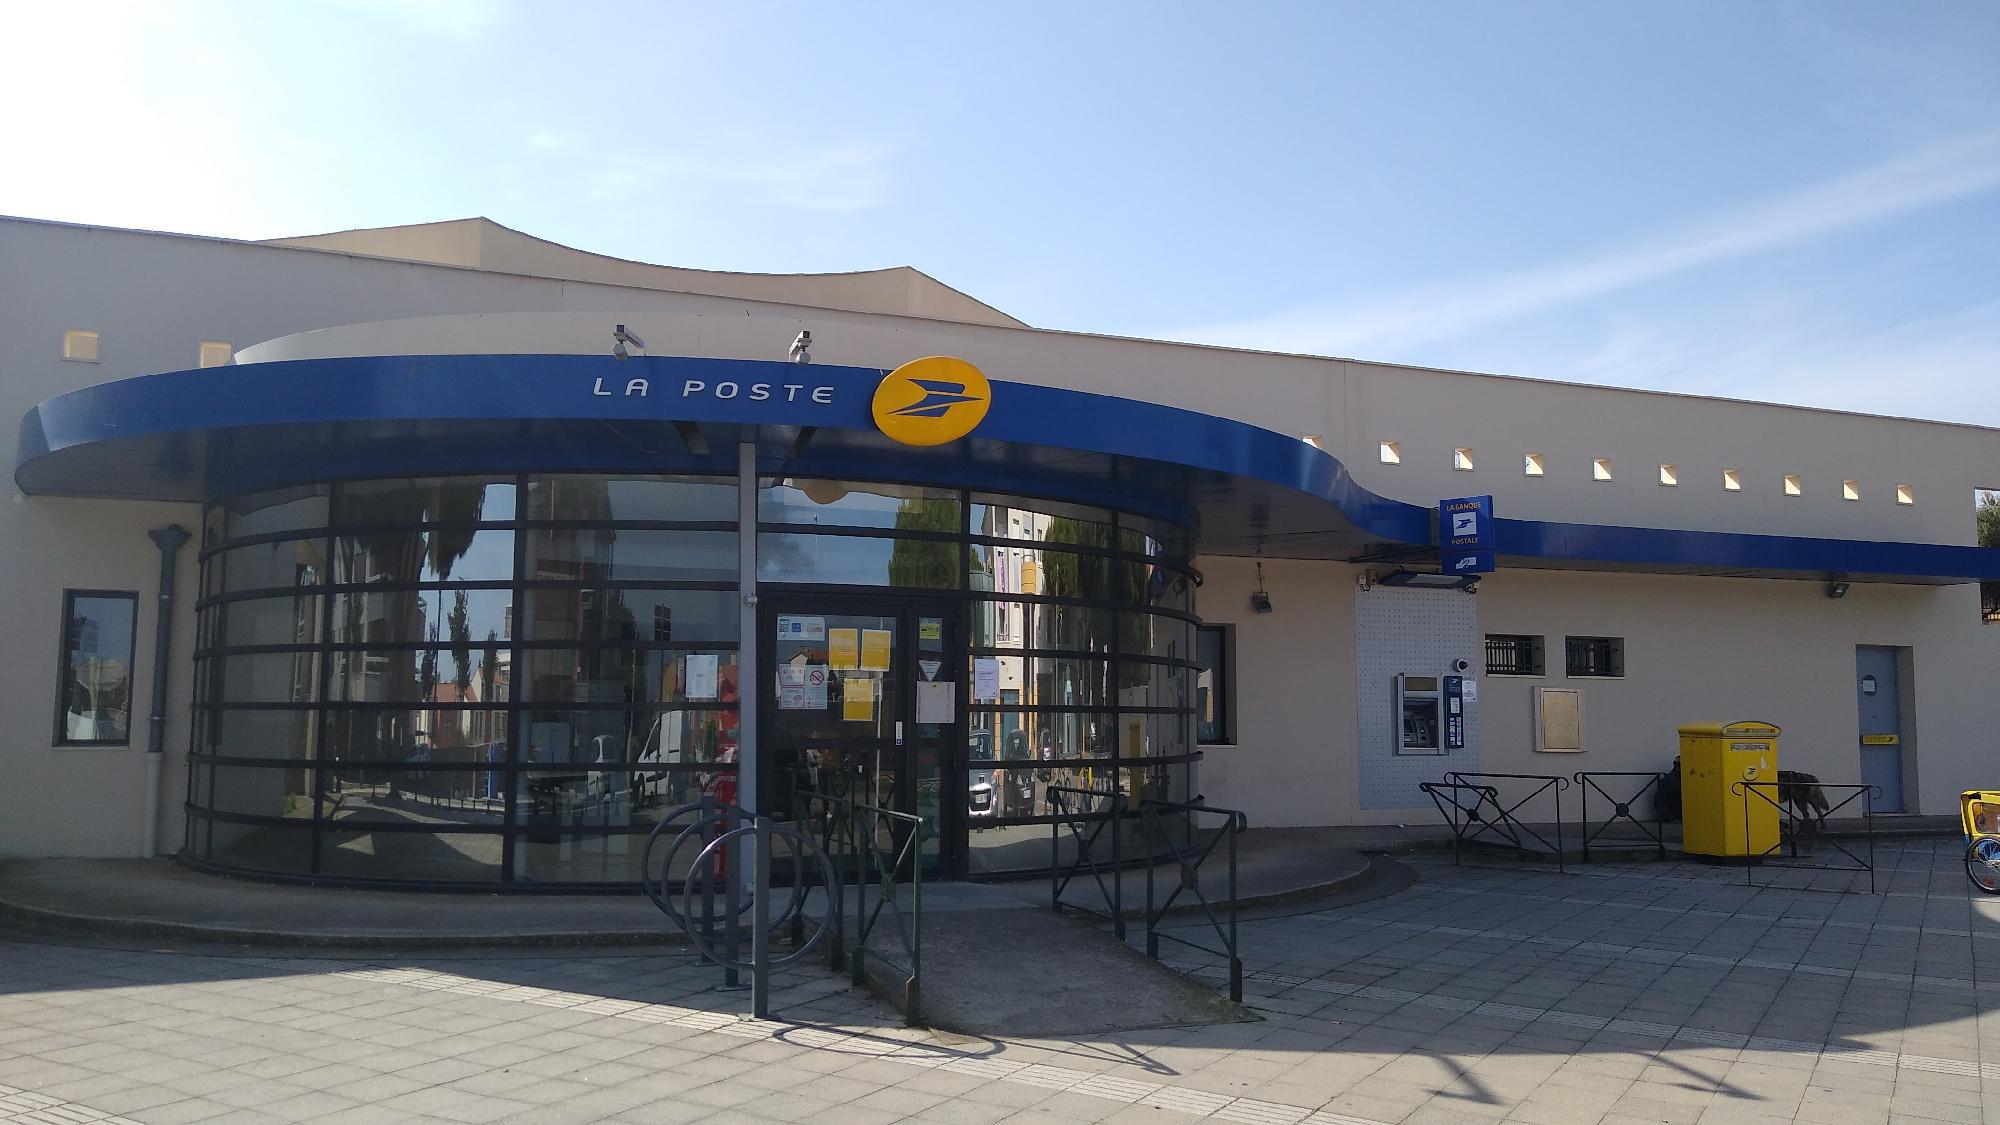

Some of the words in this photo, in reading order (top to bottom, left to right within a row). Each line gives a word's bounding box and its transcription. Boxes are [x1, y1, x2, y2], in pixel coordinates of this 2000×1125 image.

[592, 377, 648, 396] LA
[683, 380, 834, 403] POSTE
[1452, 537, 1479, 545] POSTALE
